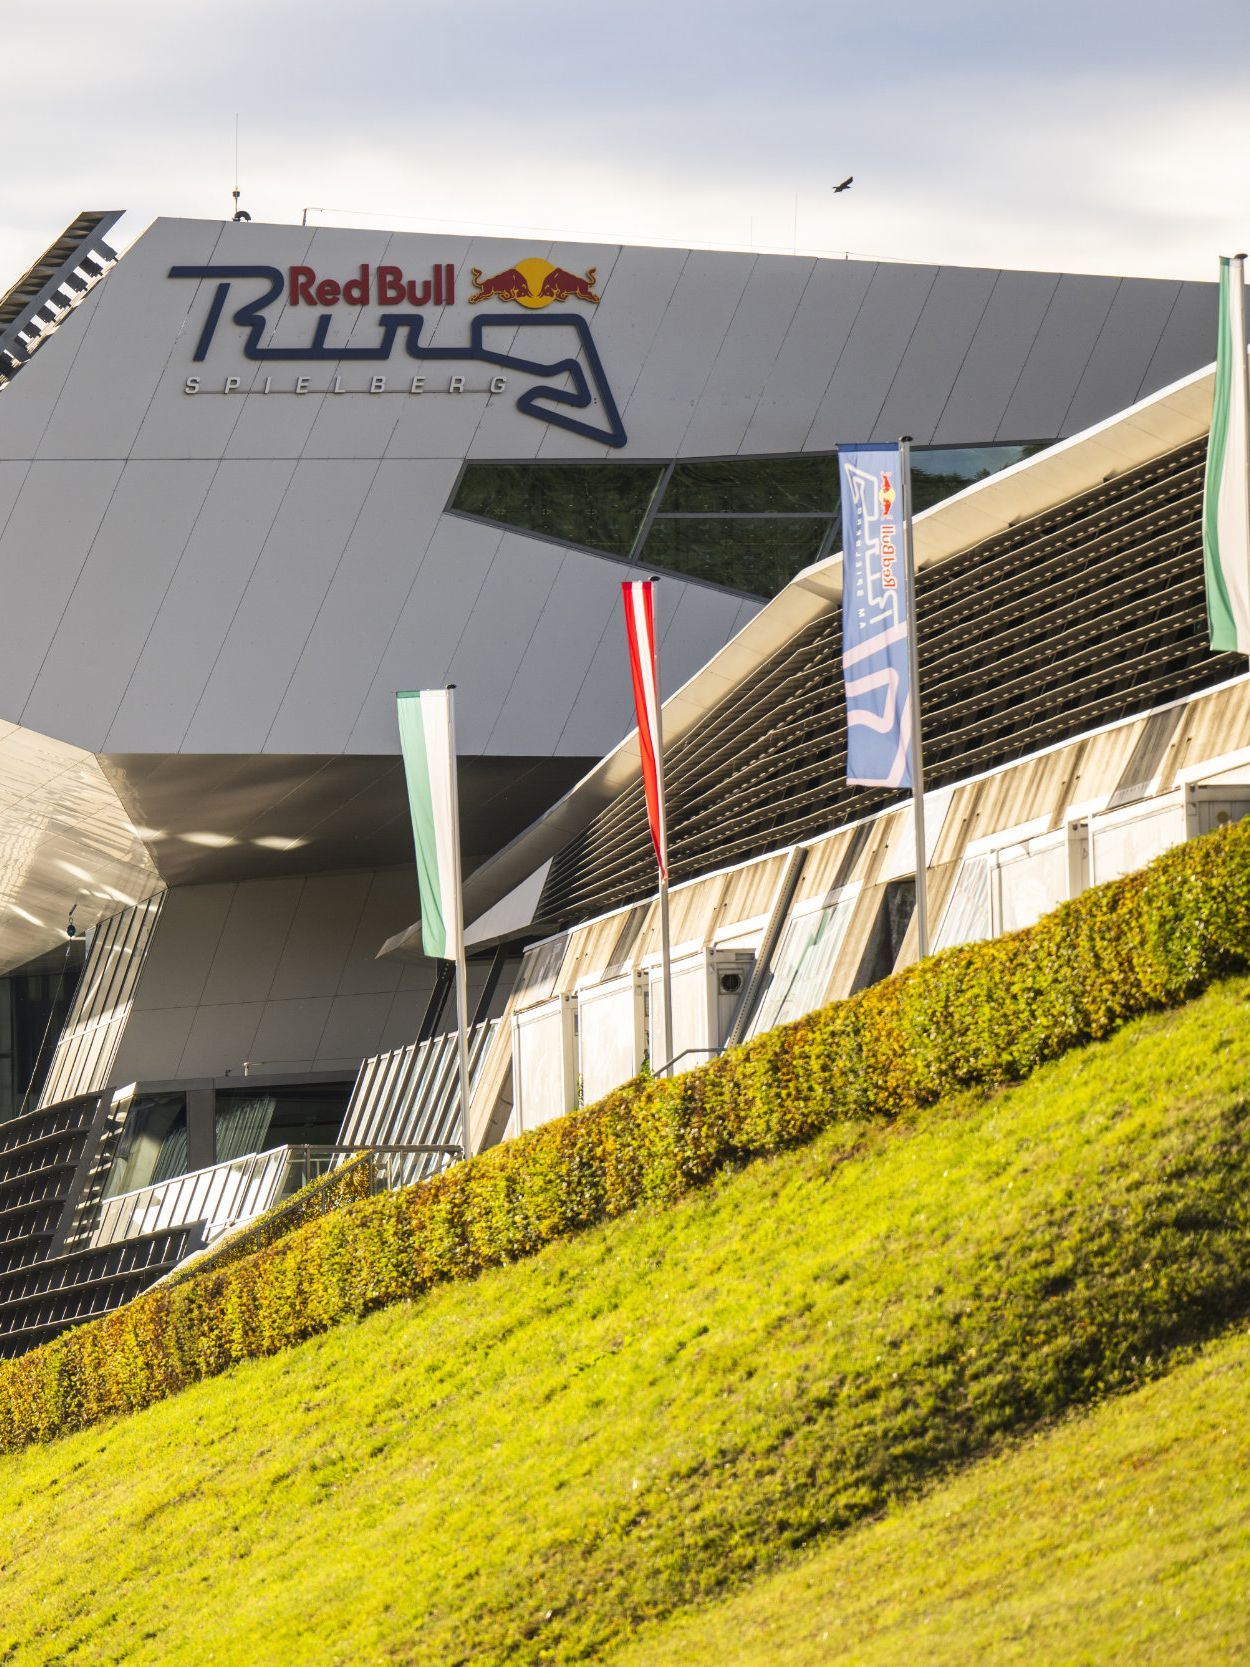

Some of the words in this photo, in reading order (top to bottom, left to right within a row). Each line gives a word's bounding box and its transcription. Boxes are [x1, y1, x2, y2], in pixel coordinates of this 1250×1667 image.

[289, 263, 369, 306] Red
[377, 263, 454, 306] Bull
[184, 376, 507, 394] SPIELBERG
